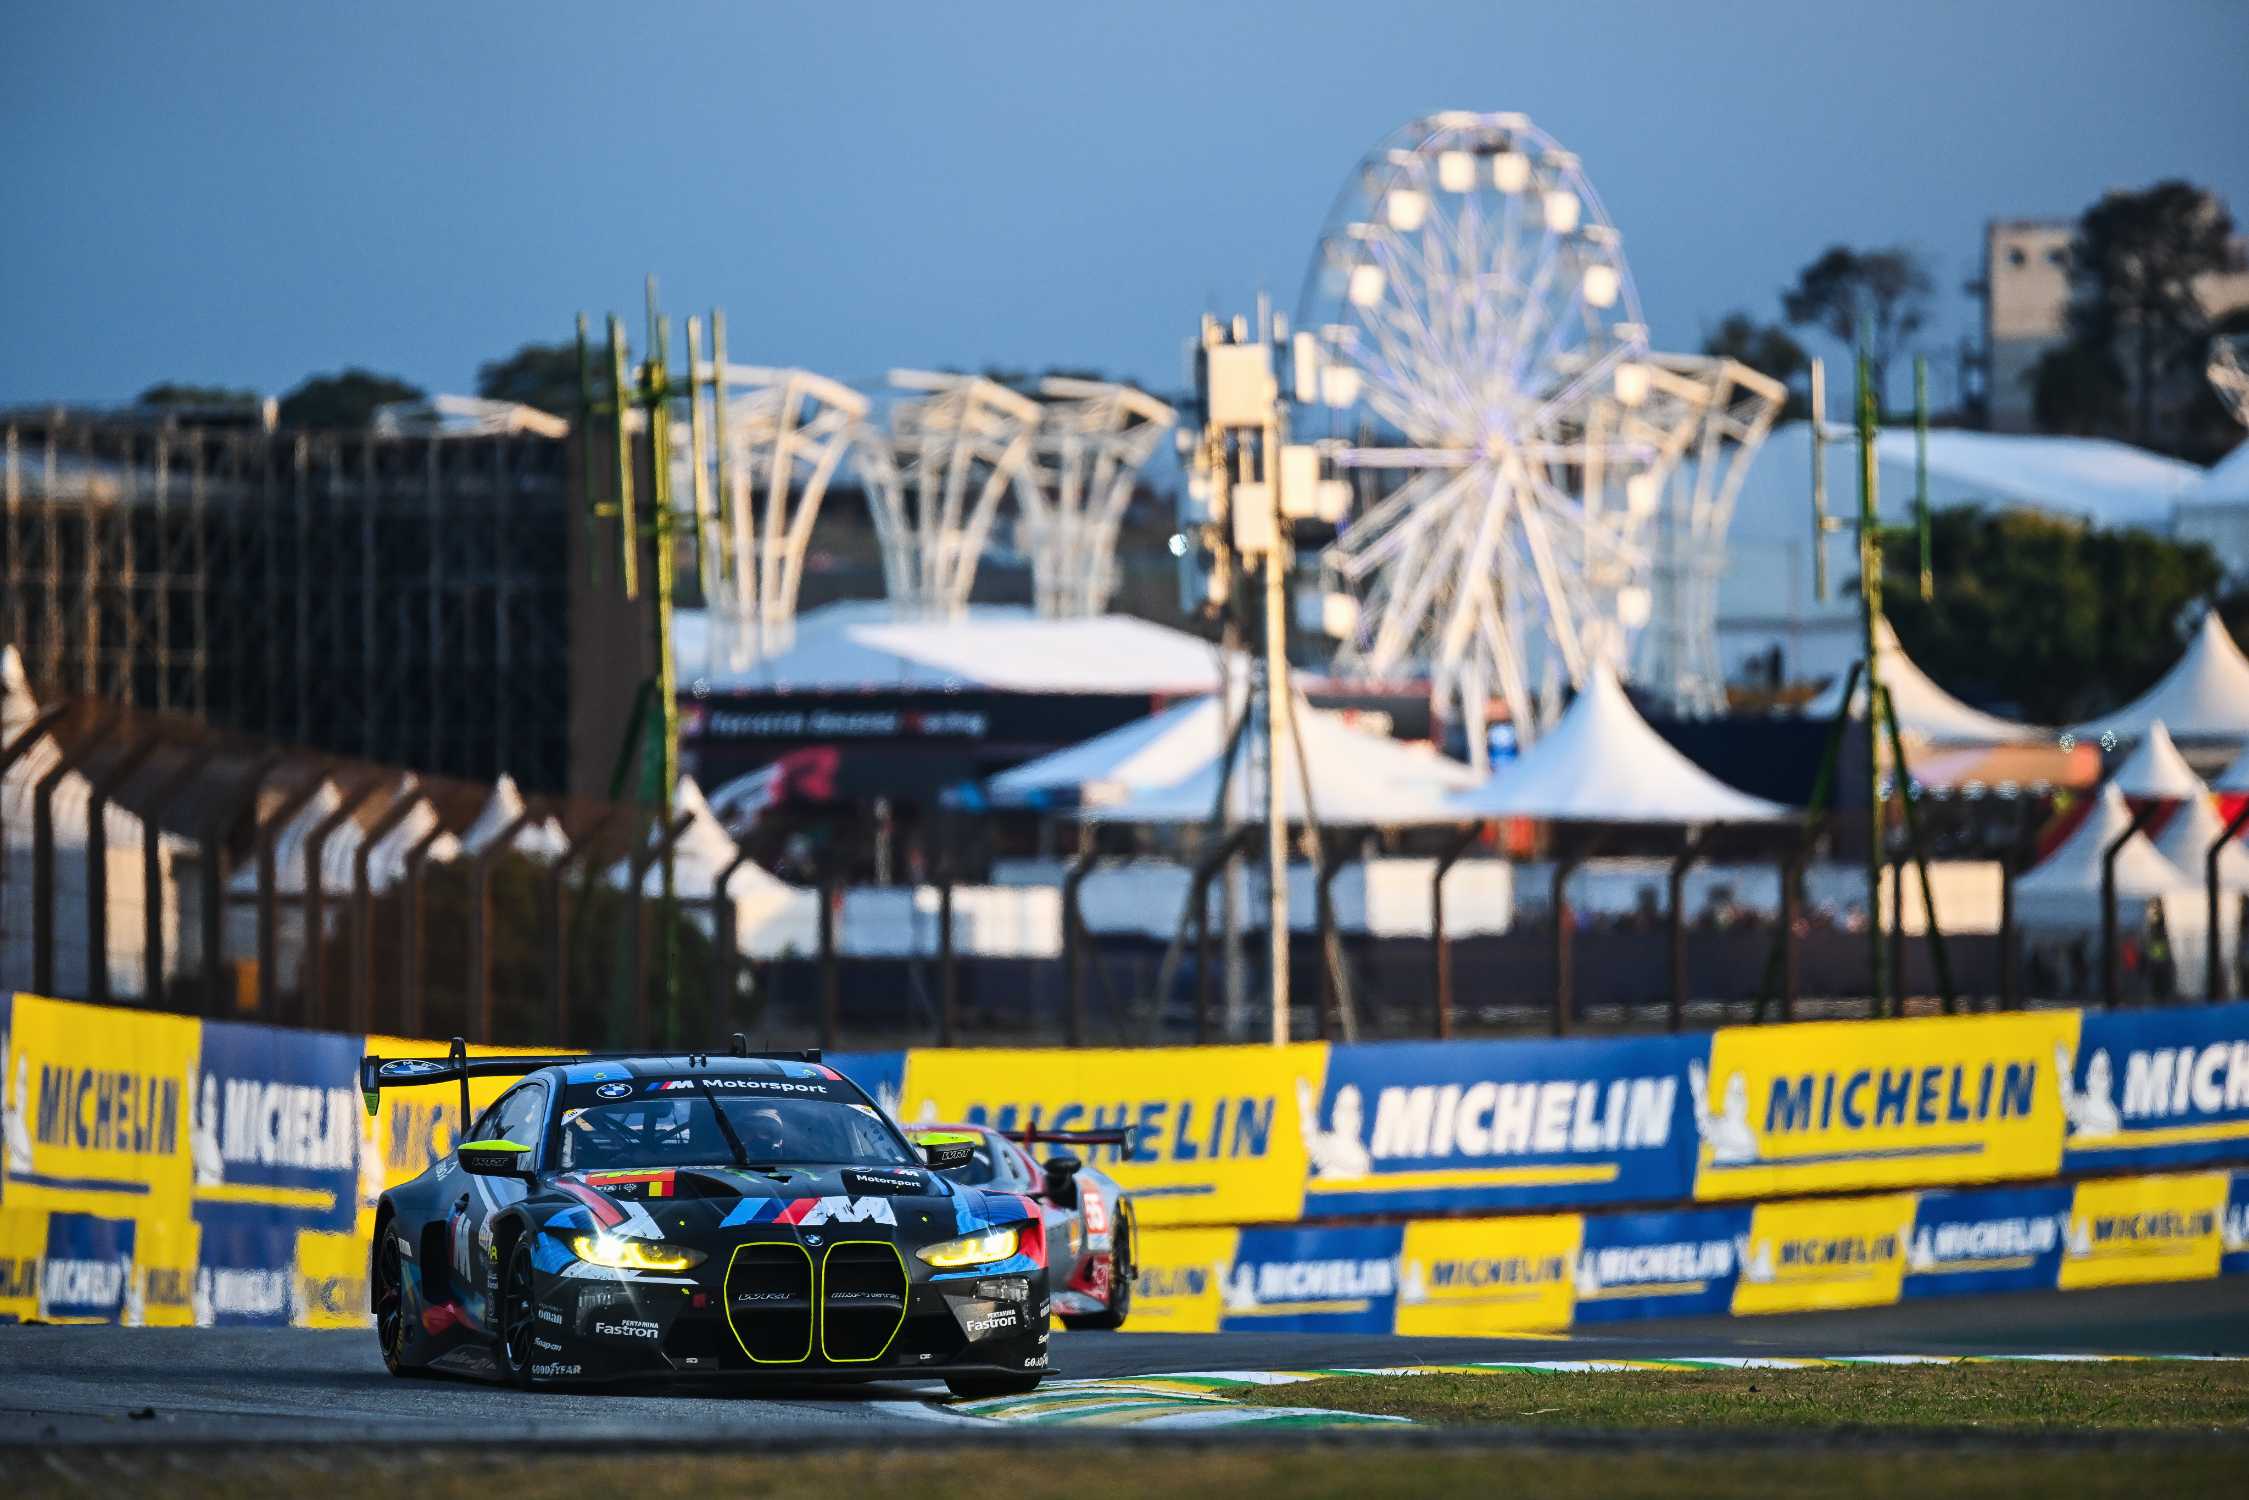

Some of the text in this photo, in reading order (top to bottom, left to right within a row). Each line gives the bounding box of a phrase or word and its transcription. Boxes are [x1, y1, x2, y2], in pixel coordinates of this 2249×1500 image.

[702, 1079, 828, 1094] Motorsport
[1764, 1060, 2038, 1133] MICHELIN
[38, 1064, 180, 1155] MICHELIN
[222, 1078, 354, 1170] MICHELIN
[1371, 1075, 1678, 1159] MICHELIN
[856, 1174, 921, 1188] Motorsport
[1935, 1217, 2055, 1261] MICHELIN
[2094, 1211, 2213, 1243] MICHELIN
[1599, 1239, 1734, 1285] MICHELIN
[1779, 1233, 1897, 1266] MICHELIN
[1256, 1258, 1395, 1299] MICHELIN
[1432, 1257, 1564, 1287] MICHELIN
[595, 1321, 658, 1339] Fastron
[966, 1315, 1017, 1332] Fastron
